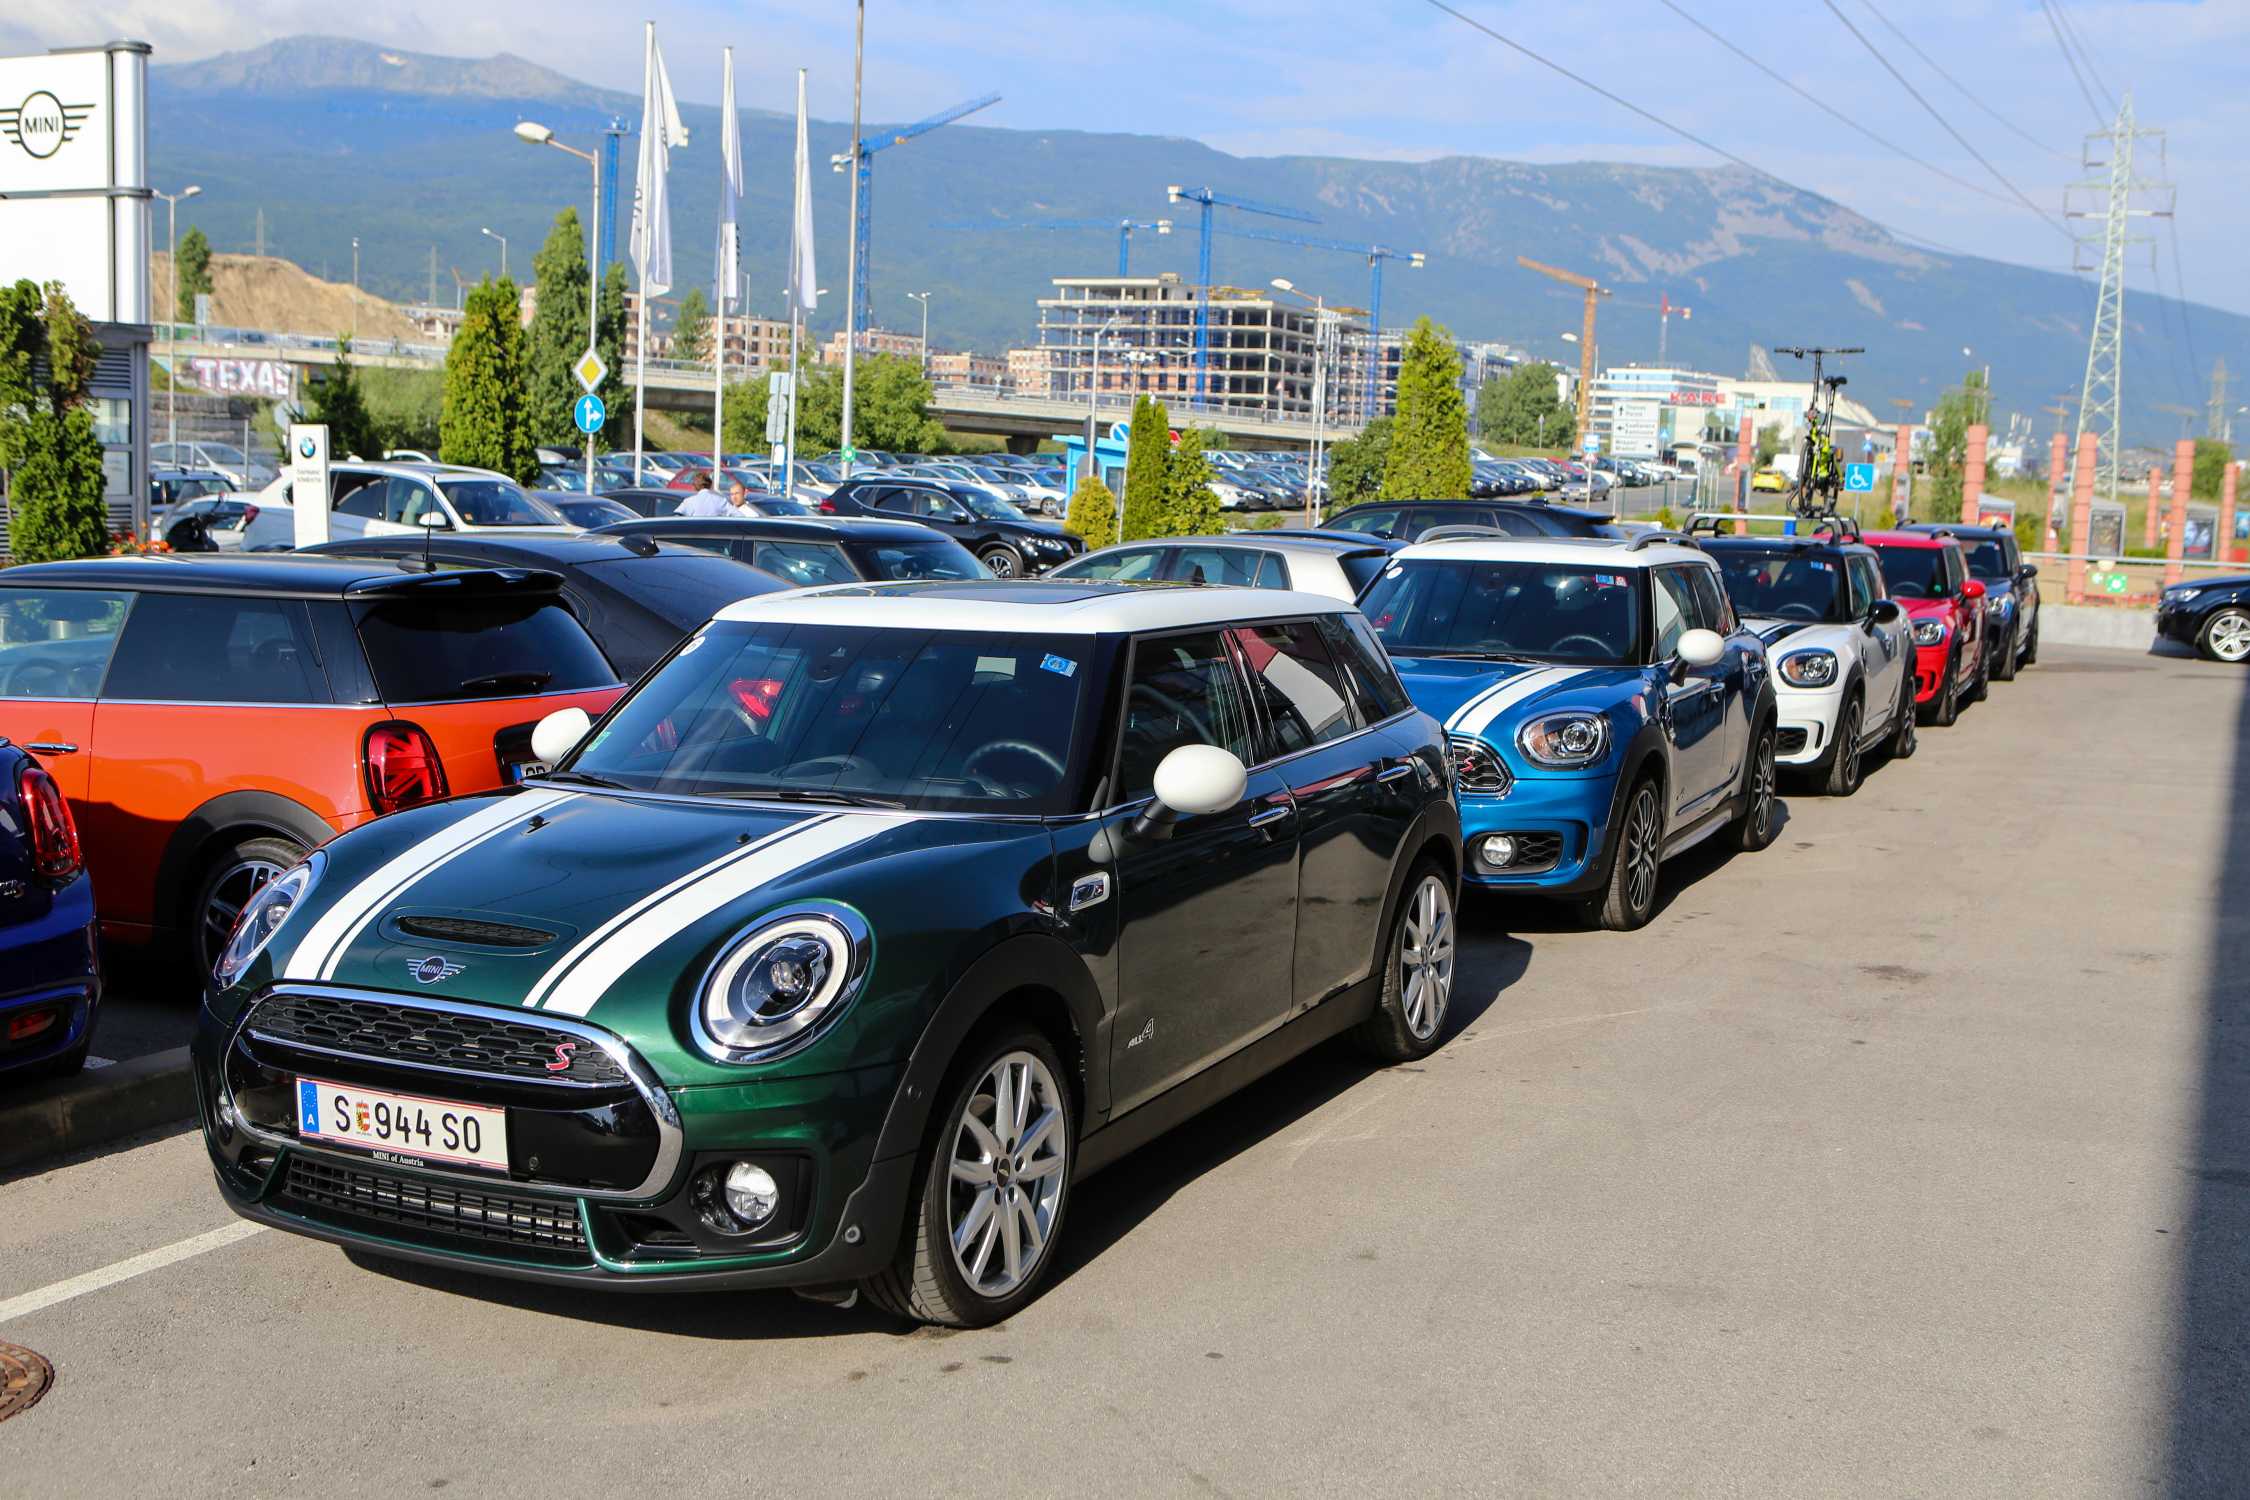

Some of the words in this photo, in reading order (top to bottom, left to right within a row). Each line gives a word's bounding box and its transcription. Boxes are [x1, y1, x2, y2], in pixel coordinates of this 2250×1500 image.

[24, 116, 59, 133] MINI
[192, 359, 292, 396] TEXAS
[1670, 391, 1726, 405] KARE
[419, 963, 442, 974] MINI
[545, 1042, 576, 1071] S
[306, 1113, 316, 1126] A
[334, 1094, 351, 1133] S
[374, 1102, 432, 1147] 944
[372, 1150, 390, 1161] MINI
[390, 1154, 399, 1163] of
[399, 1155, 425, 1167] Austria
